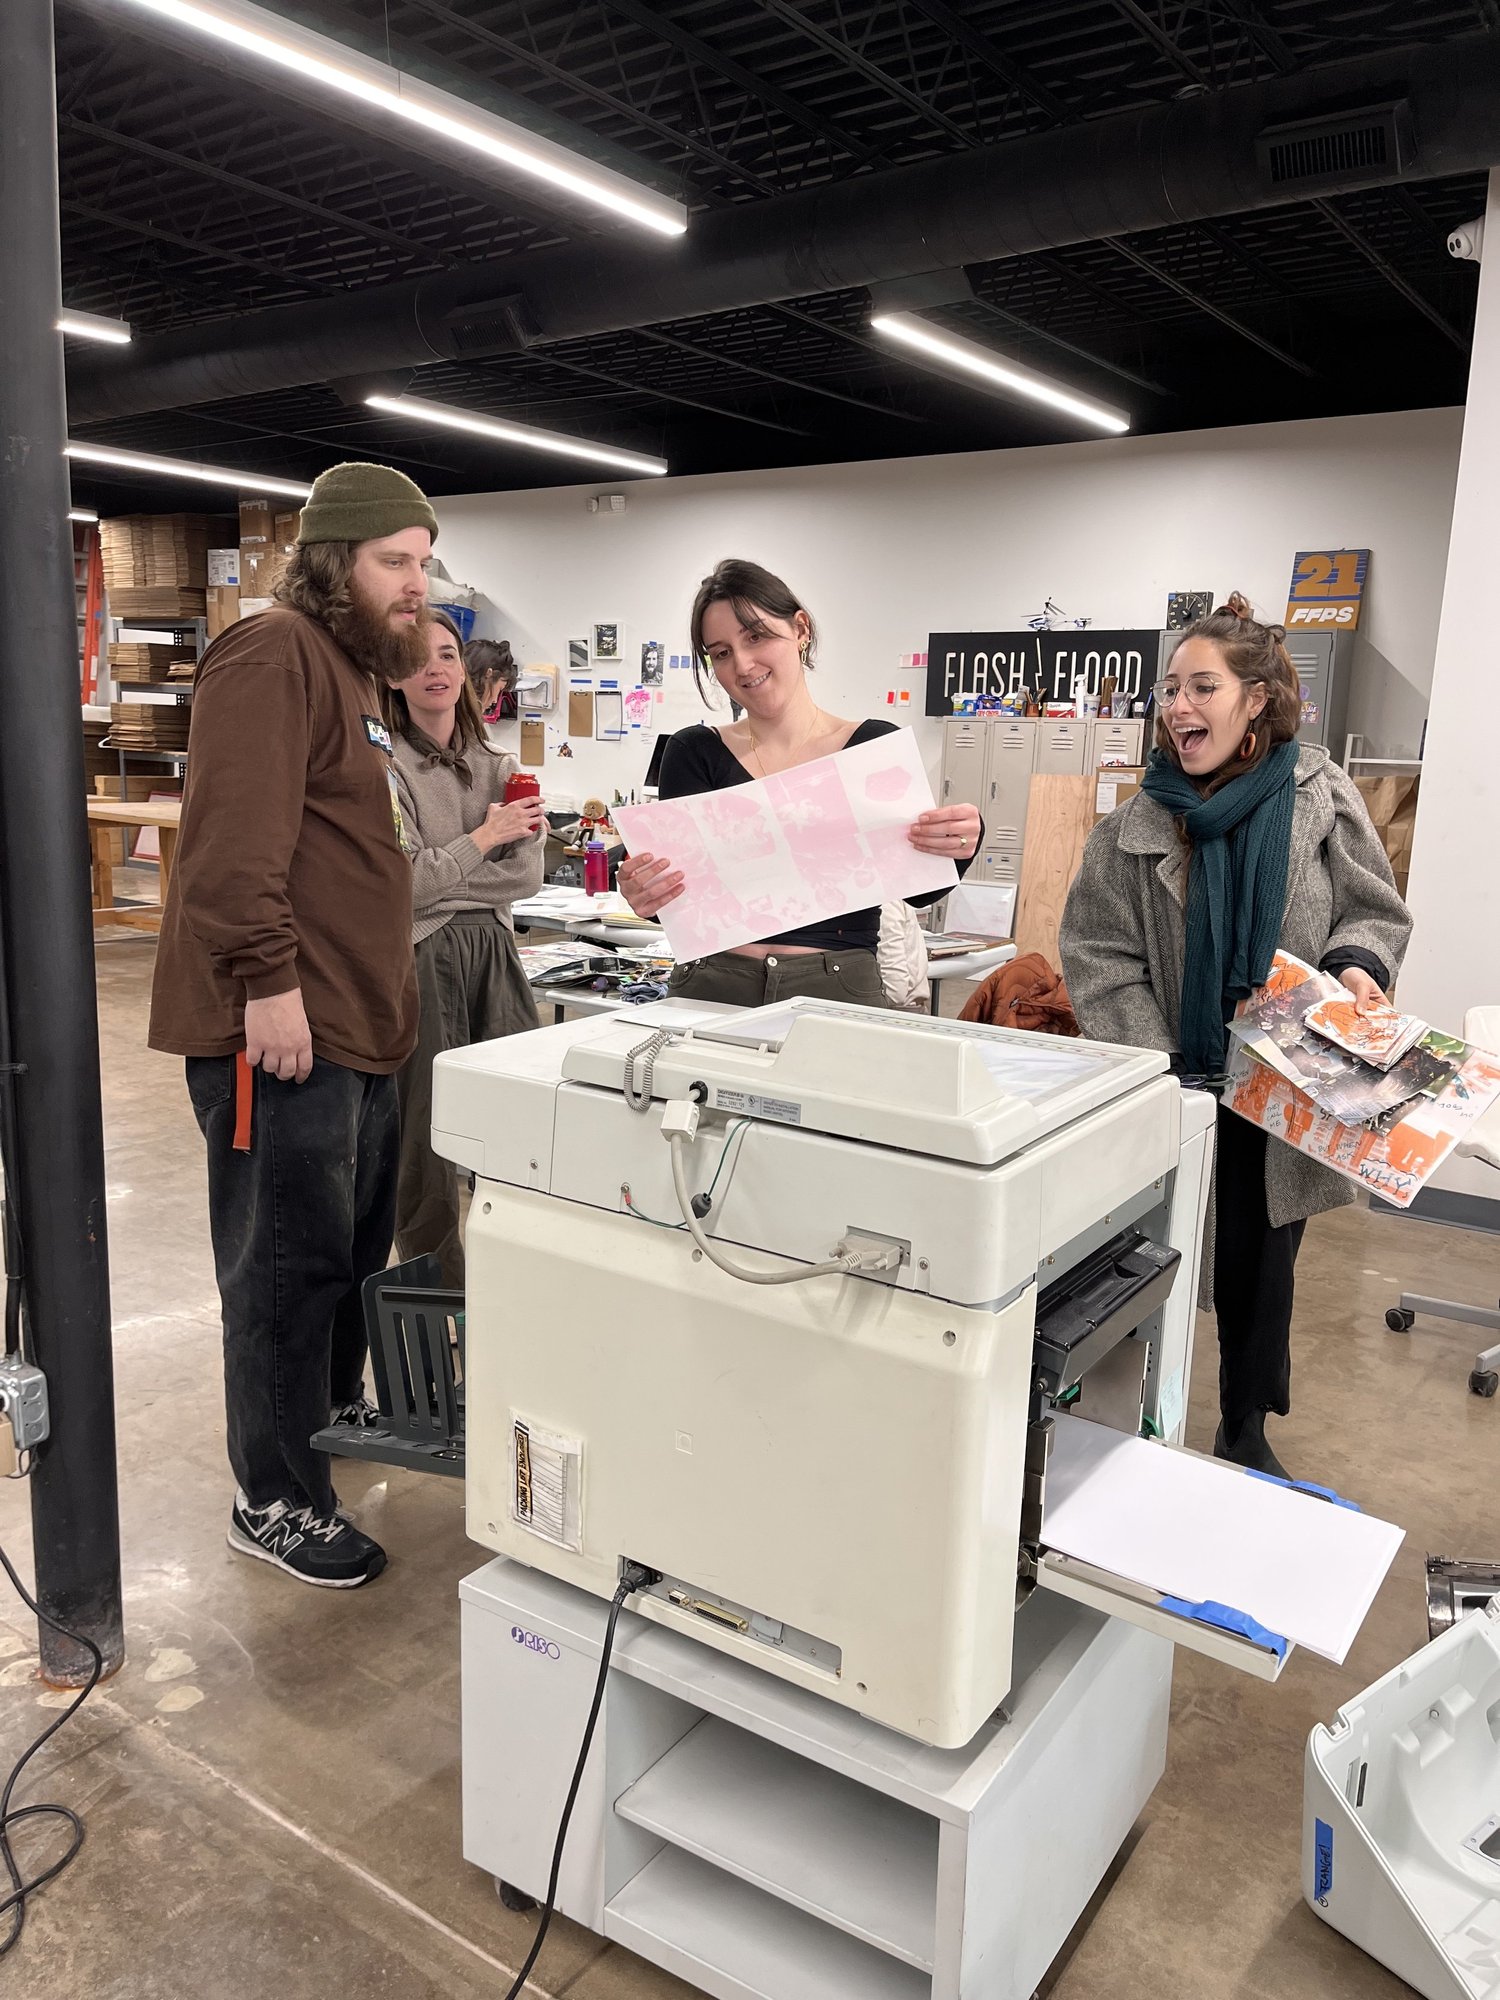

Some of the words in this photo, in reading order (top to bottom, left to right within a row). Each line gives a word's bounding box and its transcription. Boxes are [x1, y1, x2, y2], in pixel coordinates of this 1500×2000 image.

[1294, 554, 1361, 597] 21
[1290, 607, 1354, 623] FFPS
[944, 651, 1025, 698] FLASH
[1053, 651, 1143, 700] FLOOD
[1267, 1112, 1282, 1121] CALL
[1269, 1120, 1281, 1128] ME
[1336, 1141, 1361, 1149] WHEN
[1336, 1152, 1355, 1161] ASK
[1359, 1163, 1411, 1195] WHY
[519, 1486, 528, 1517] PACKING
[524, 1631, 560, 1660] RISO
